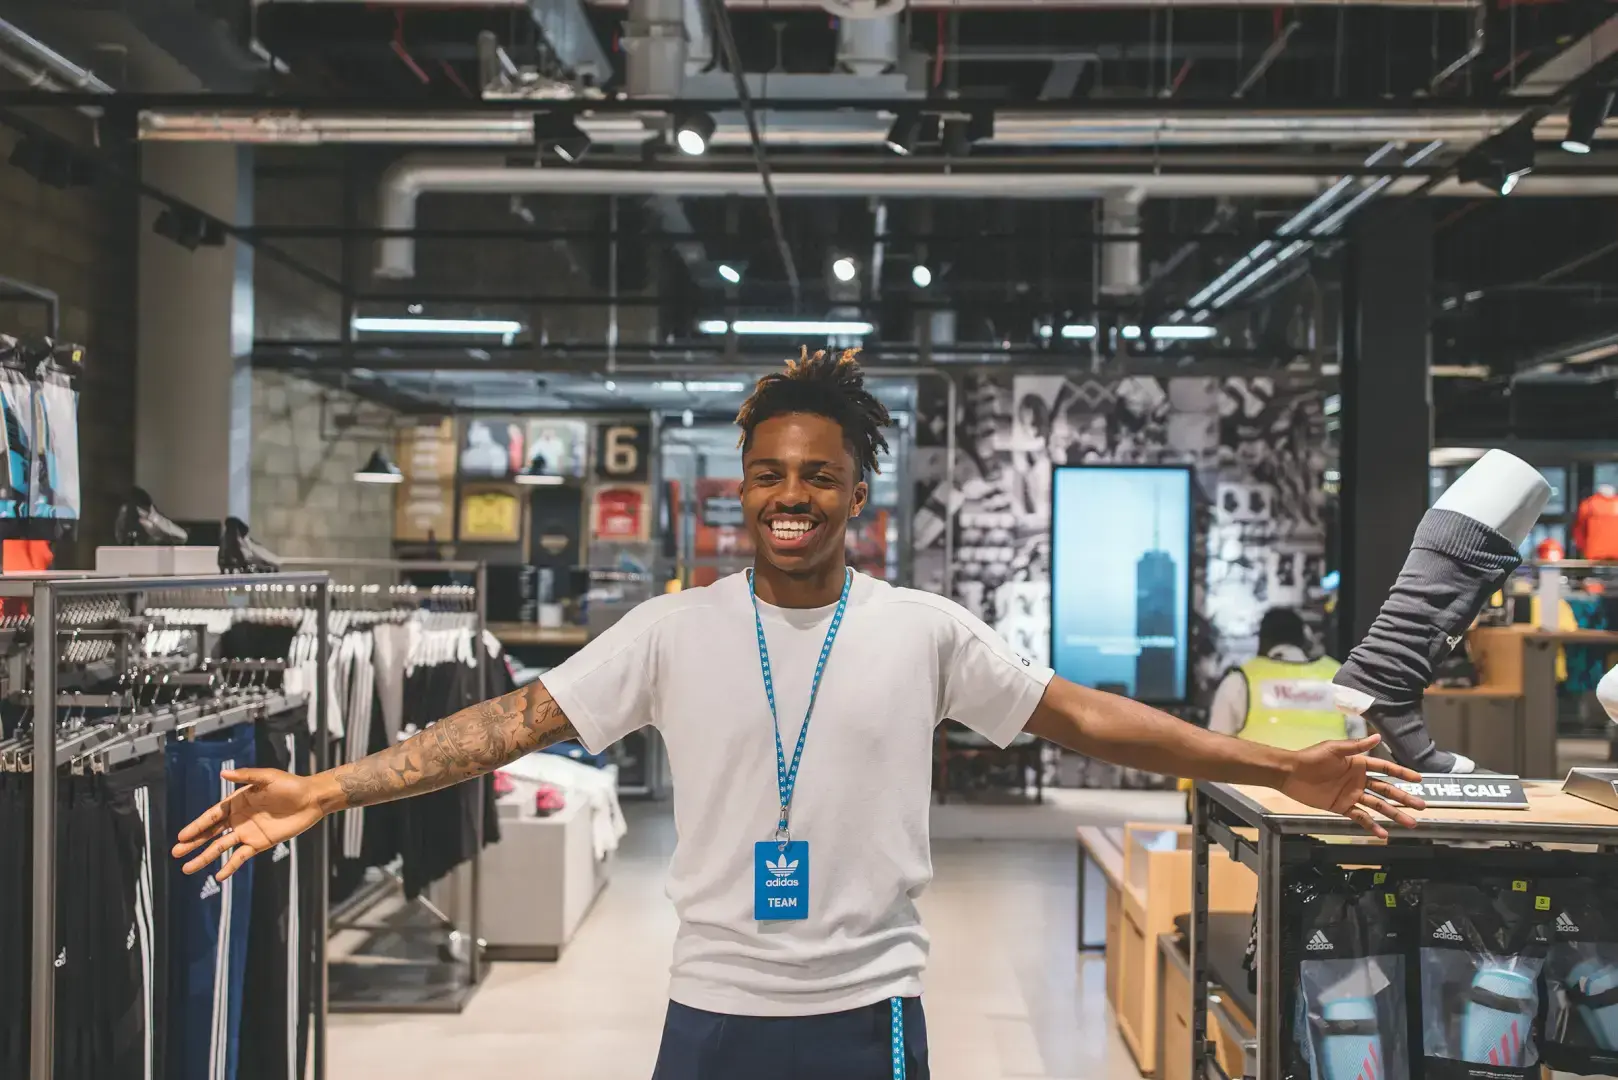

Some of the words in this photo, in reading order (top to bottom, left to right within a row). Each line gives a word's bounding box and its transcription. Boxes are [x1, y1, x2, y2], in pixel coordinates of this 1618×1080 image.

[605, 426, 638, 474] 6
[1424, 784, 1463, 797] THE
[1463, 785, 1512, 798] CALF
[765, 877, 799, 887] adidas
[767, 897, 797, 908] TEAM
[1556, 924, 1580, 932] didas
[1432, 931, 1464, 942] adidas
[1305, 943, 1334, 951] adidas
